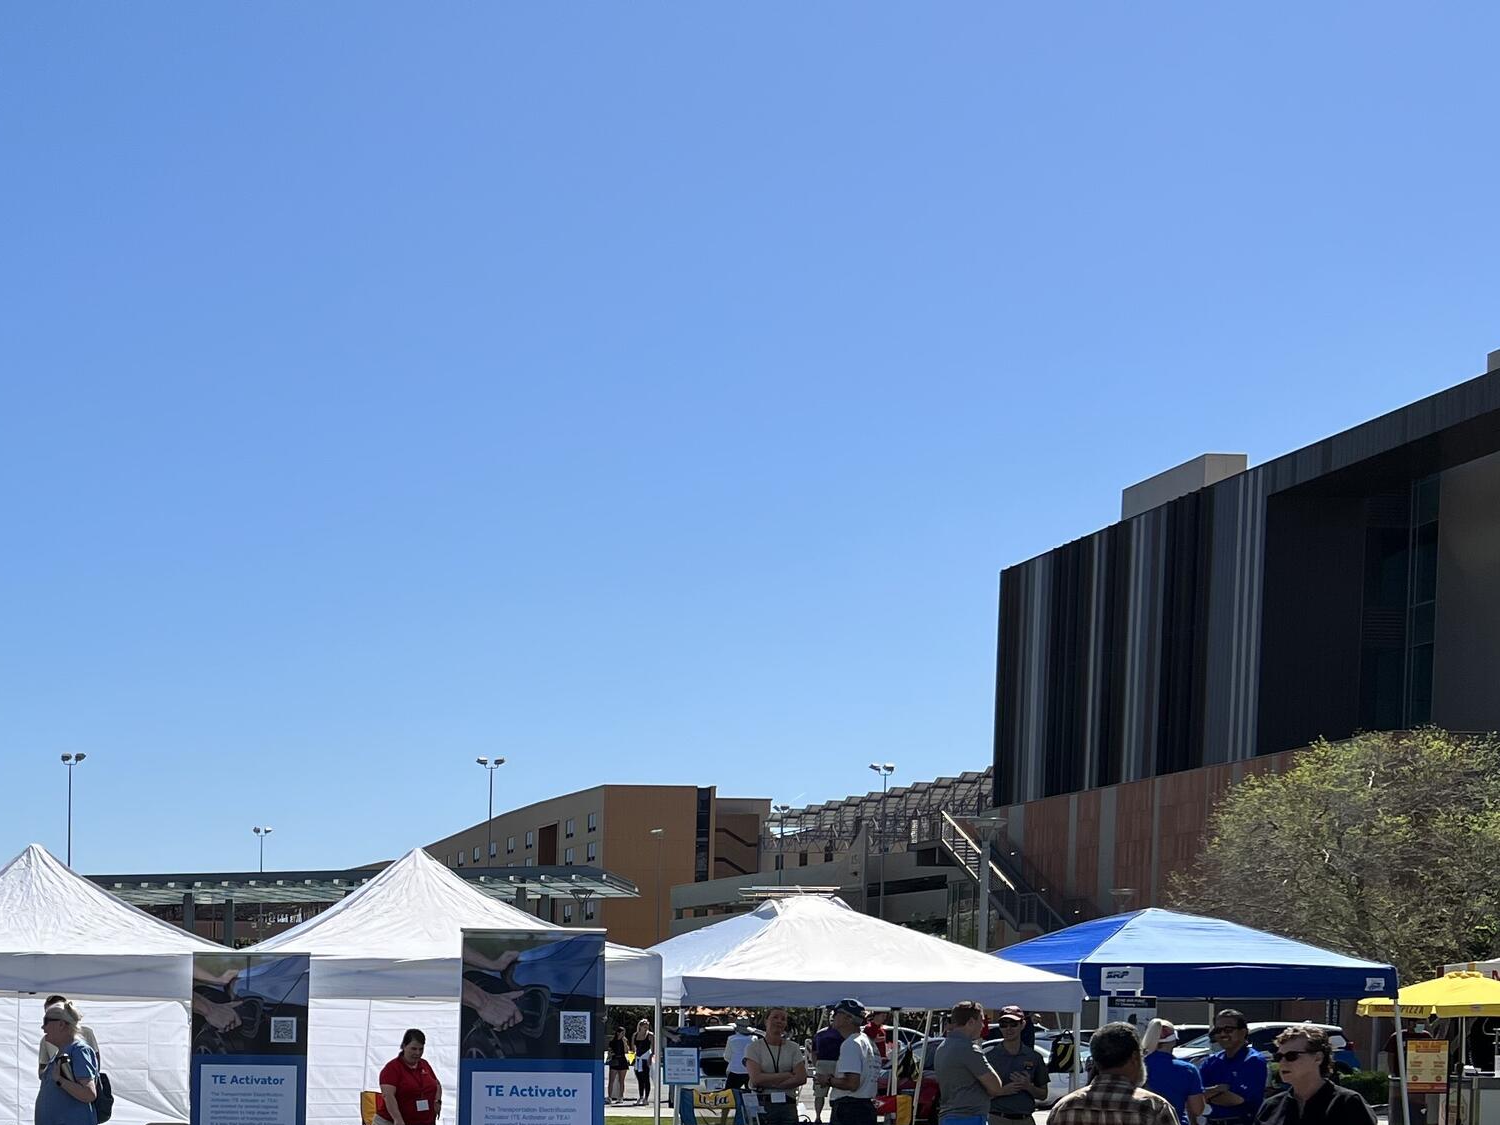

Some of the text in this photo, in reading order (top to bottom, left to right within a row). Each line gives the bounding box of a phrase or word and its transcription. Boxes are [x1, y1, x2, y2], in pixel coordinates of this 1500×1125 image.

[212, 1074, 284, 1085] TE Activator
[485, 1084, 578, 1097] TE Activator
